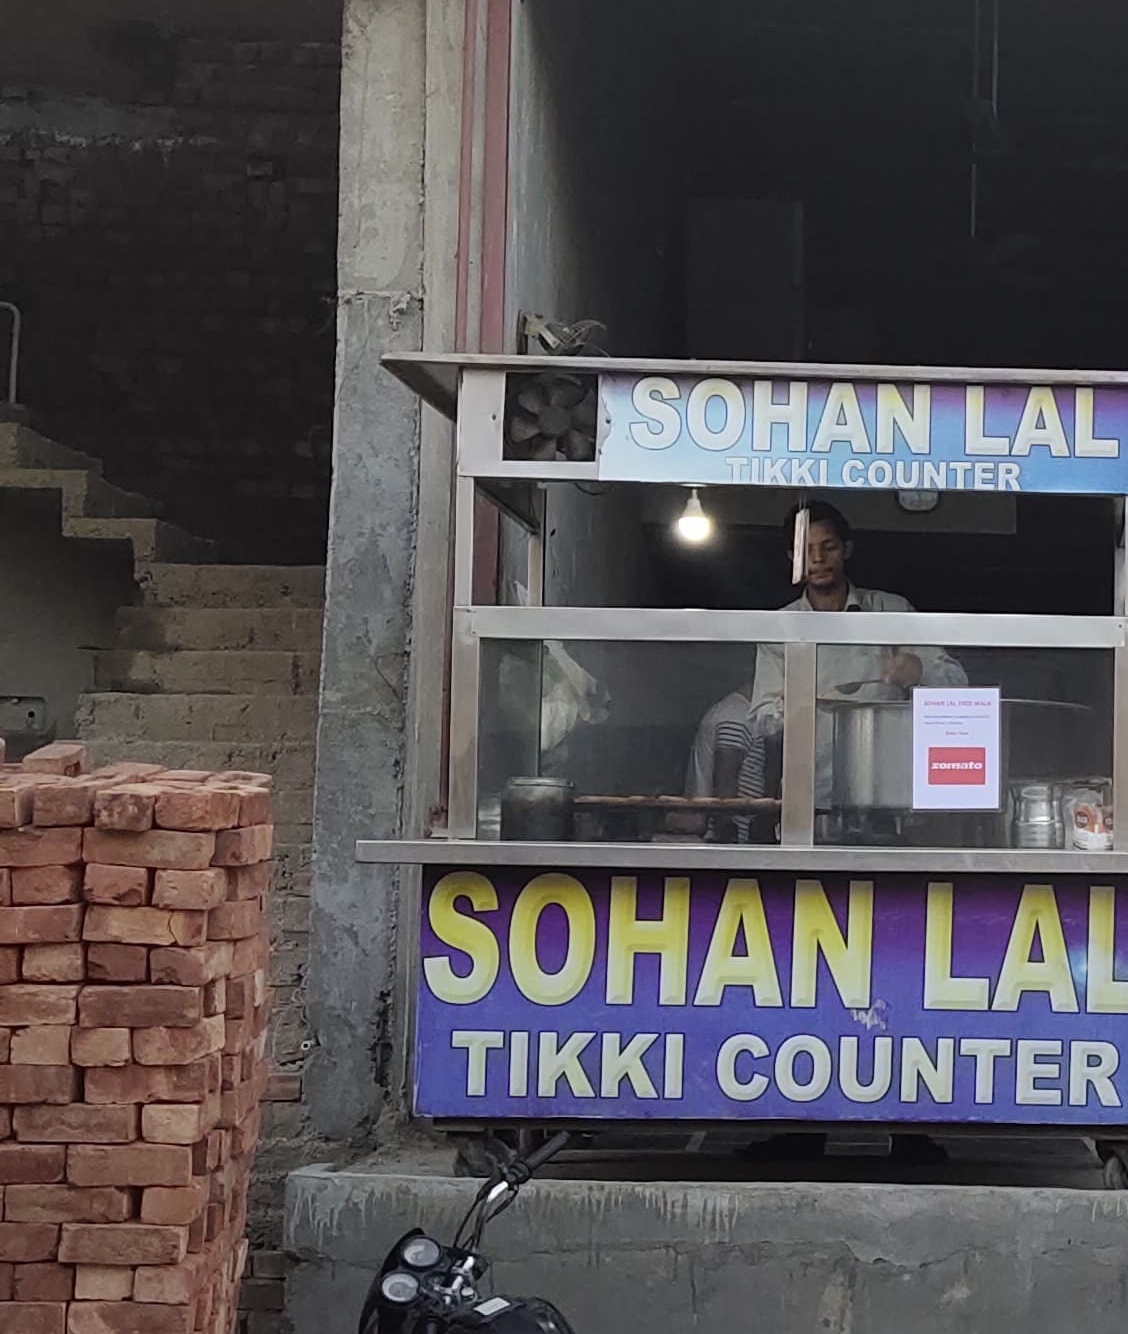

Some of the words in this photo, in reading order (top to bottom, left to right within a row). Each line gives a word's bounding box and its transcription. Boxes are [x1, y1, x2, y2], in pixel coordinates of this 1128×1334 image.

[628, 376, 931, 454] SOHAN
[965, 384, 1120, 458] LAL
[725, 456, 827, 487] TIKKI
[841, 459, 1022, 491] COUNTER
[931, 761, 983, 770] zomato
[422, 871, 875, 1010] SOHAN
[450, 1029, 686, 1100] TIKKI
[714, 1032, 1124, 1108] COUNTER
